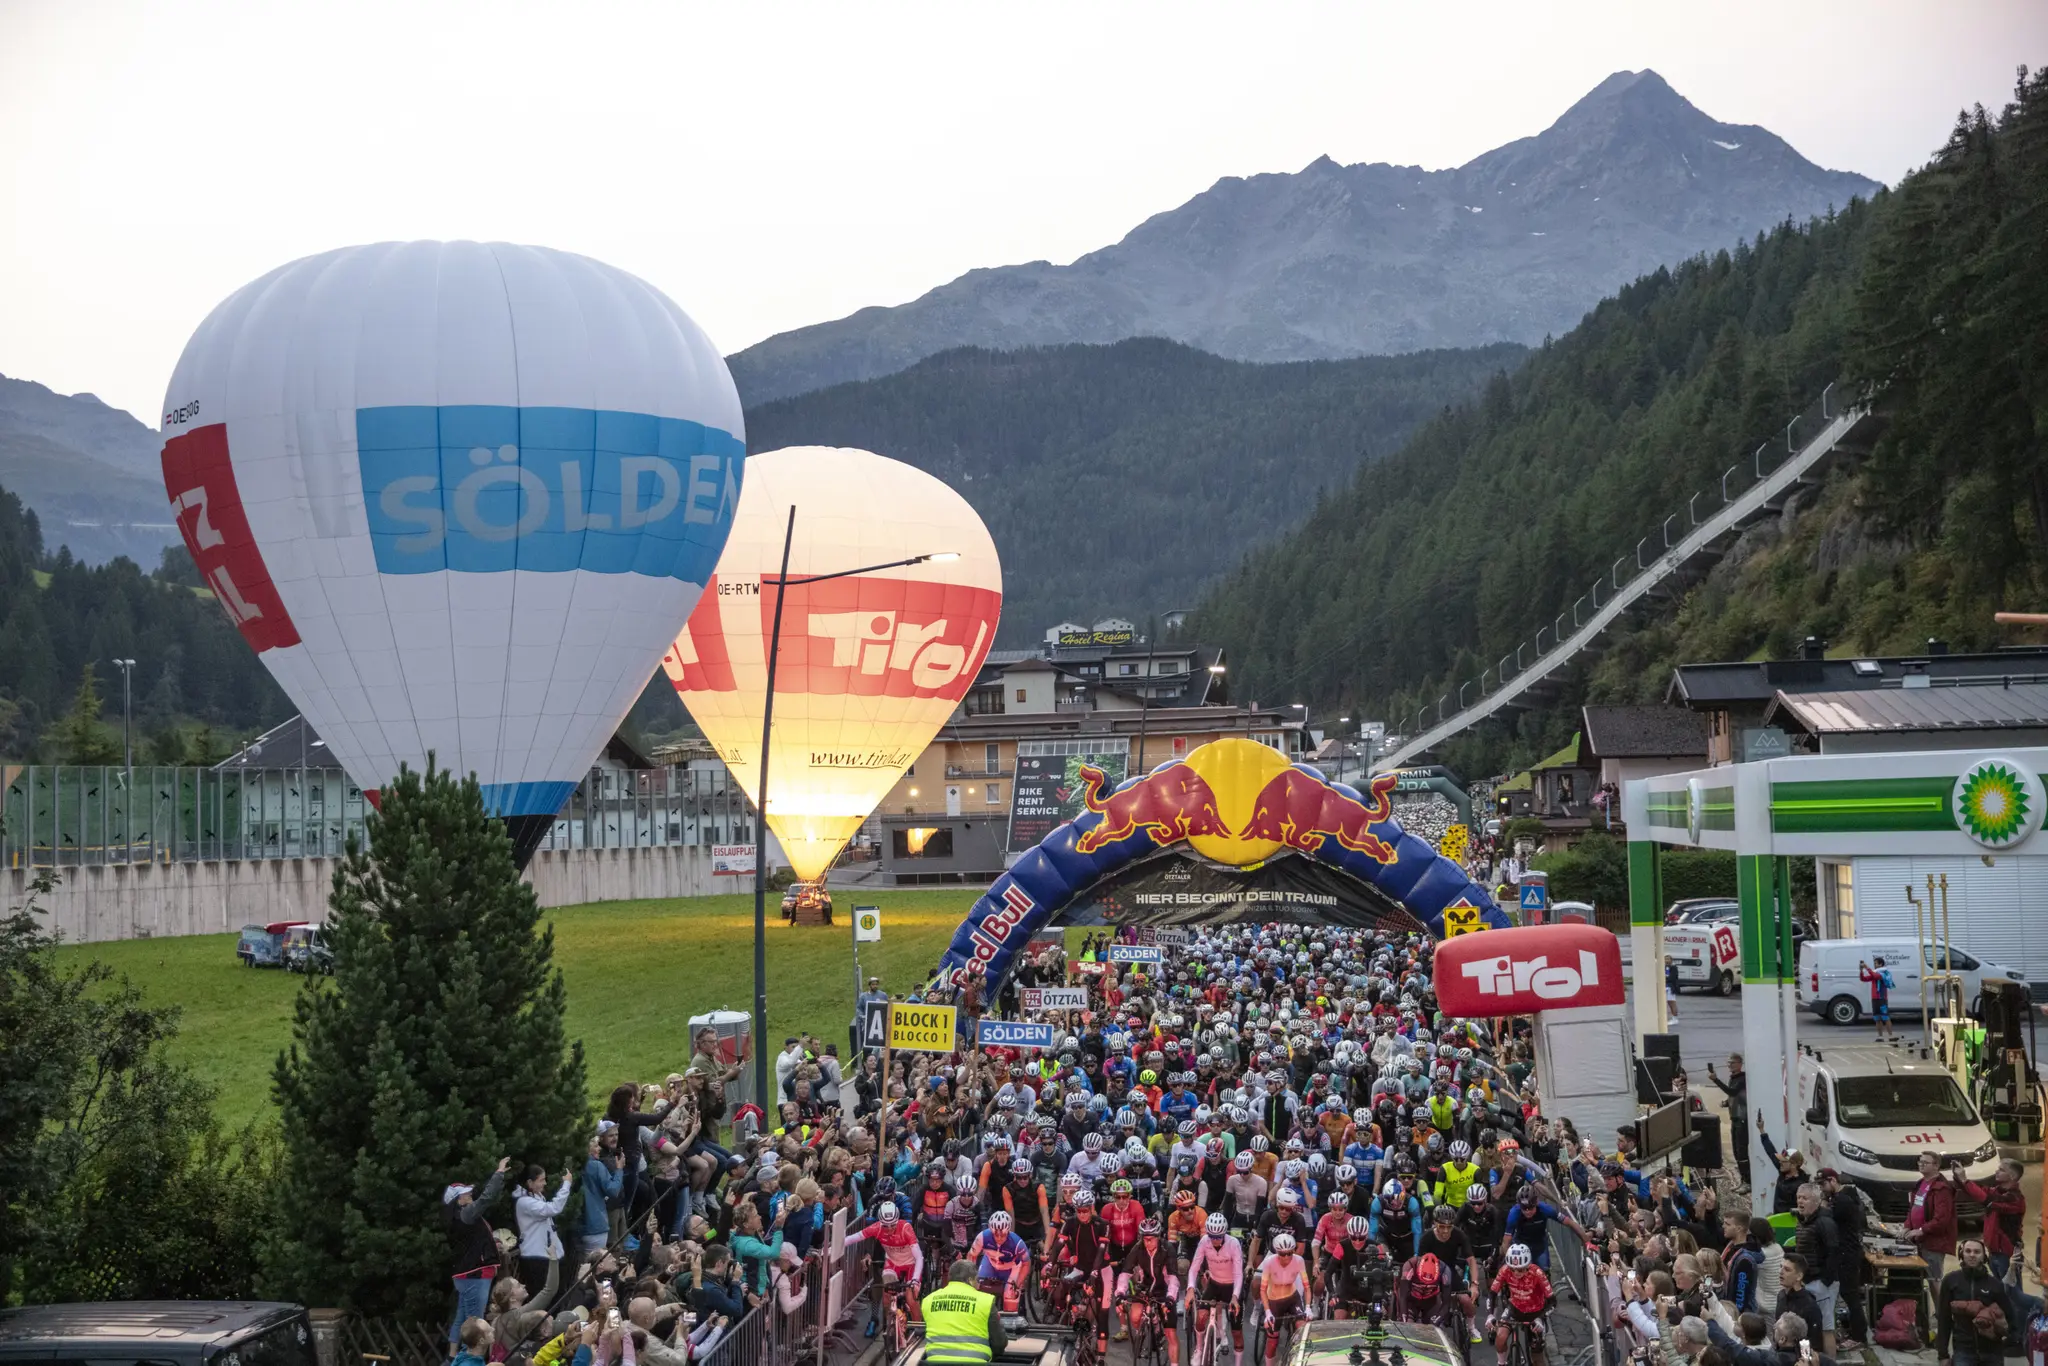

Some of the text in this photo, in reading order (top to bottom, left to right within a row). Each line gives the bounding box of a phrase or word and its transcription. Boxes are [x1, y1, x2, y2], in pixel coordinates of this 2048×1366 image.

[718, 583, 760, 596] OE-RTW
[1060, 632, 1131, 645] Hotel Regina
[808, 610, 988, 689] Tirol
[1400, 769, 1432, 779] RMIN
[1019, 787, 1043, 796] BIKE
[1396, 781, 1431, 791] ODA
[1018, 797, 1044, 806] RENT
[1016, 807, 1059, 816] SERVICE
[713, 847, 756, 857] EISLAUFPLAT
[1136, 891, 1338, 905] HIER BEGINNT DEIN TRAUM!
[950, 885, 1034, 991] Red Bull
[1156, 931, 1187, 943] ÖTZTAL
[1113, 948, 1158, 960] SÖLDEN
[1077, 962, 1106, 973] Tirol
[1461, 950, 1599, 999] Tirol
[1025, 991, 1040, 999] ÖTZ
[1043, 991, 1085, 1005] ÖTZTAL
[868, 1010, 884, 1040] A
[895, 1012, 948, 1029] BLOCK 1
[893, 1030, 947, 1043] BLOCCO 1
[983, 1025, 1047, 1041] SÖLDEN
[931, 1300, 976, 1314] RENNLEITER 1
